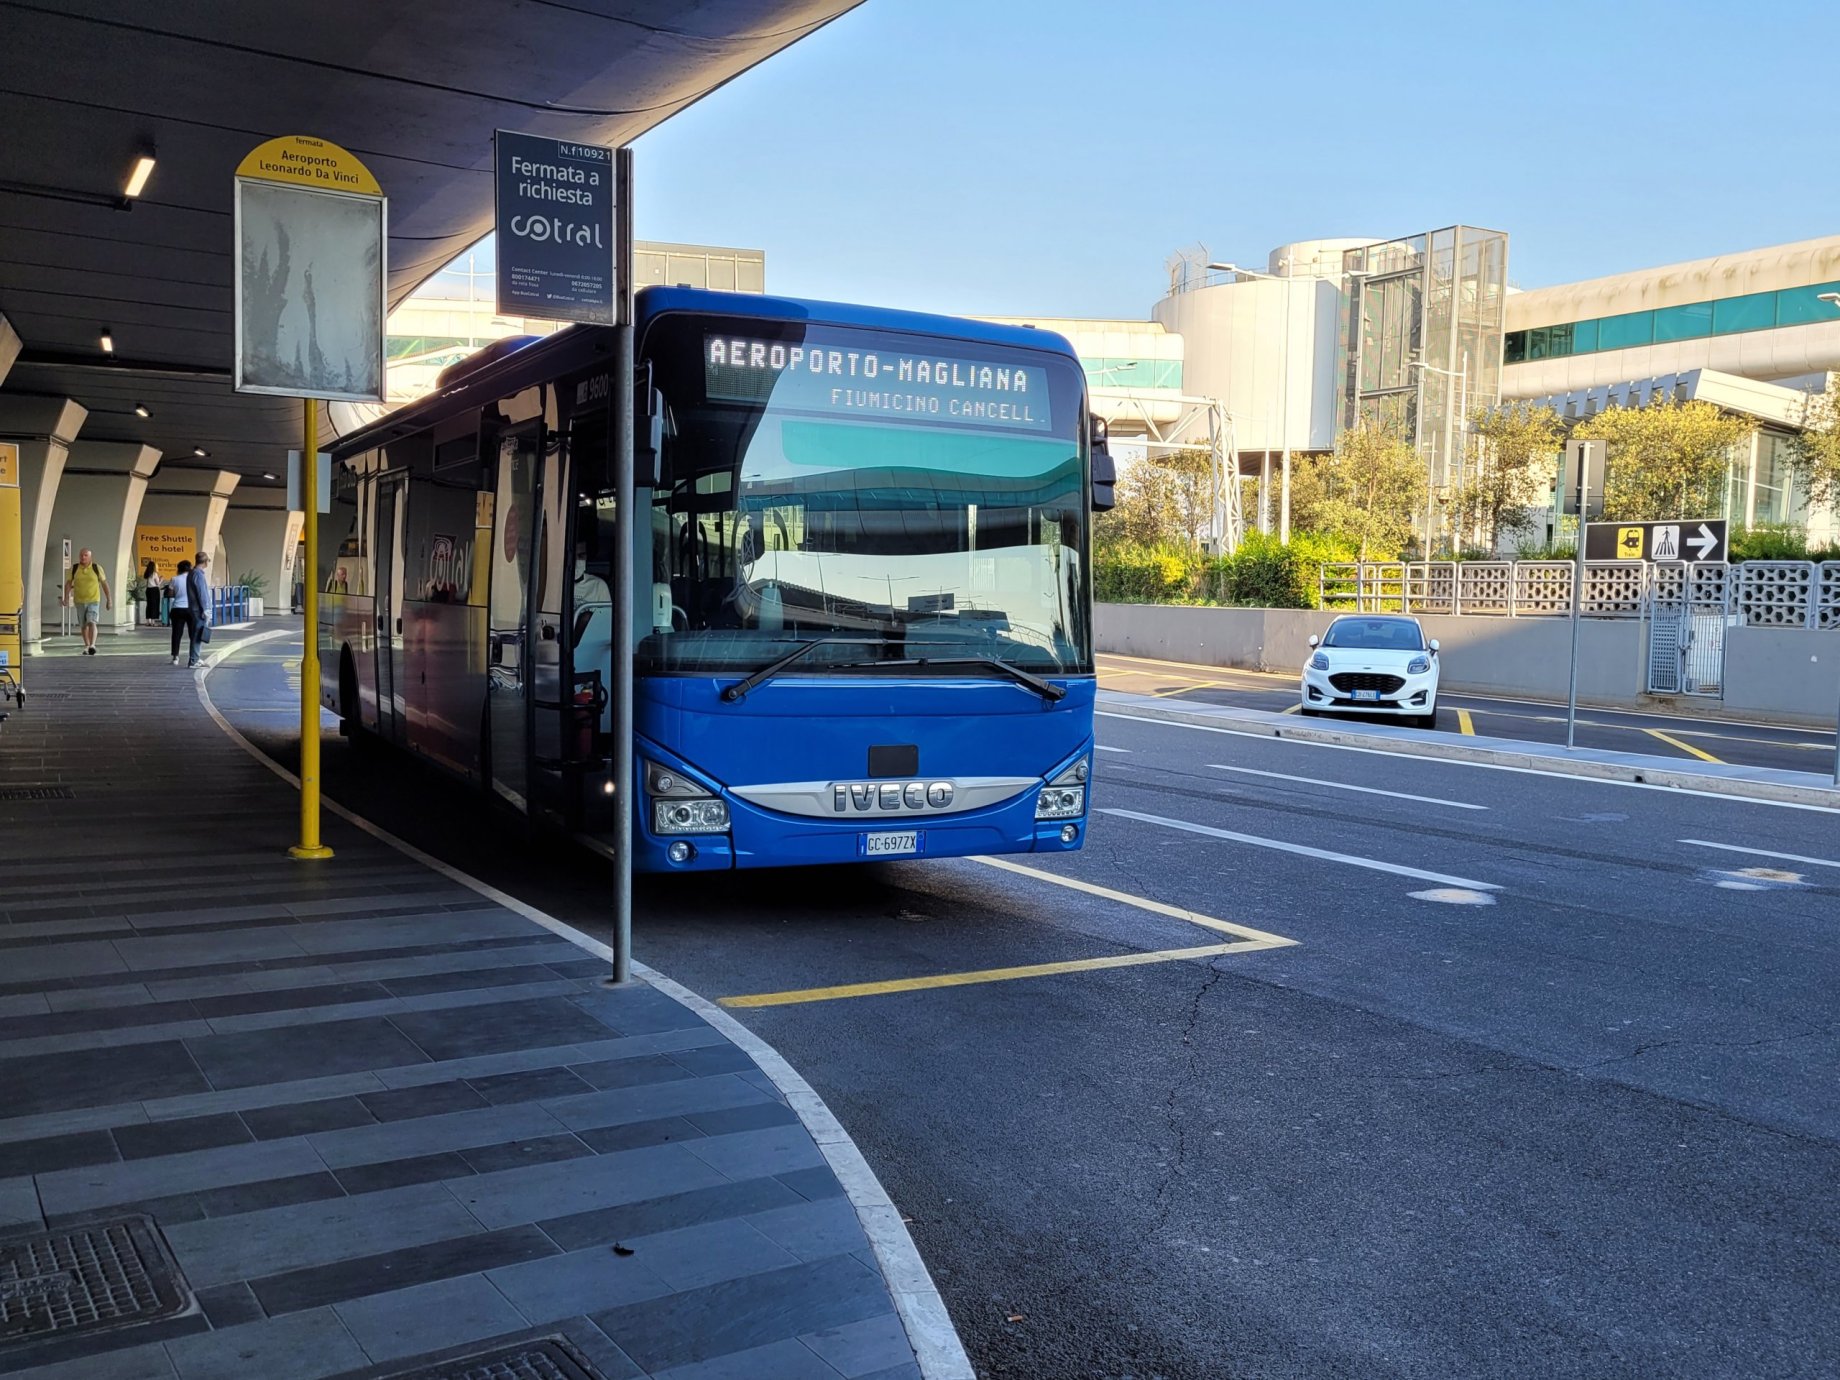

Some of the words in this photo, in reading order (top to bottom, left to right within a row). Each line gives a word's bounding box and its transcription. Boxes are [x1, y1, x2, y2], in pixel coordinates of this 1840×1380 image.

[295, 137, 323, 148] fermata
[578, 147, 611, 161] 10921
[281, 150, 337, 168] Aeroporto
[512, 156, 585, 184] Fermata
[589, 172, 600, 186] a
[260, 160, 312, 177] Leonardo
[316, 168, 329, 179] Da
[333, 171, 359, 184] Vinci
[519, 179, 593, 206] richiesta
[511, 215, 602, 249] cotral
[511, 266, 531, 274] Contact
[710, 339, 1027, 392] AEROPORTO-MAGLIANA
[831, 388, 939, 413] FIUMICINO
[140, 534, 159, 542] Free
[161, 535, 193, 543] Shuttle
[162, 545, 184, 553] hotel
[834, 782, 954, 812] IVECO
